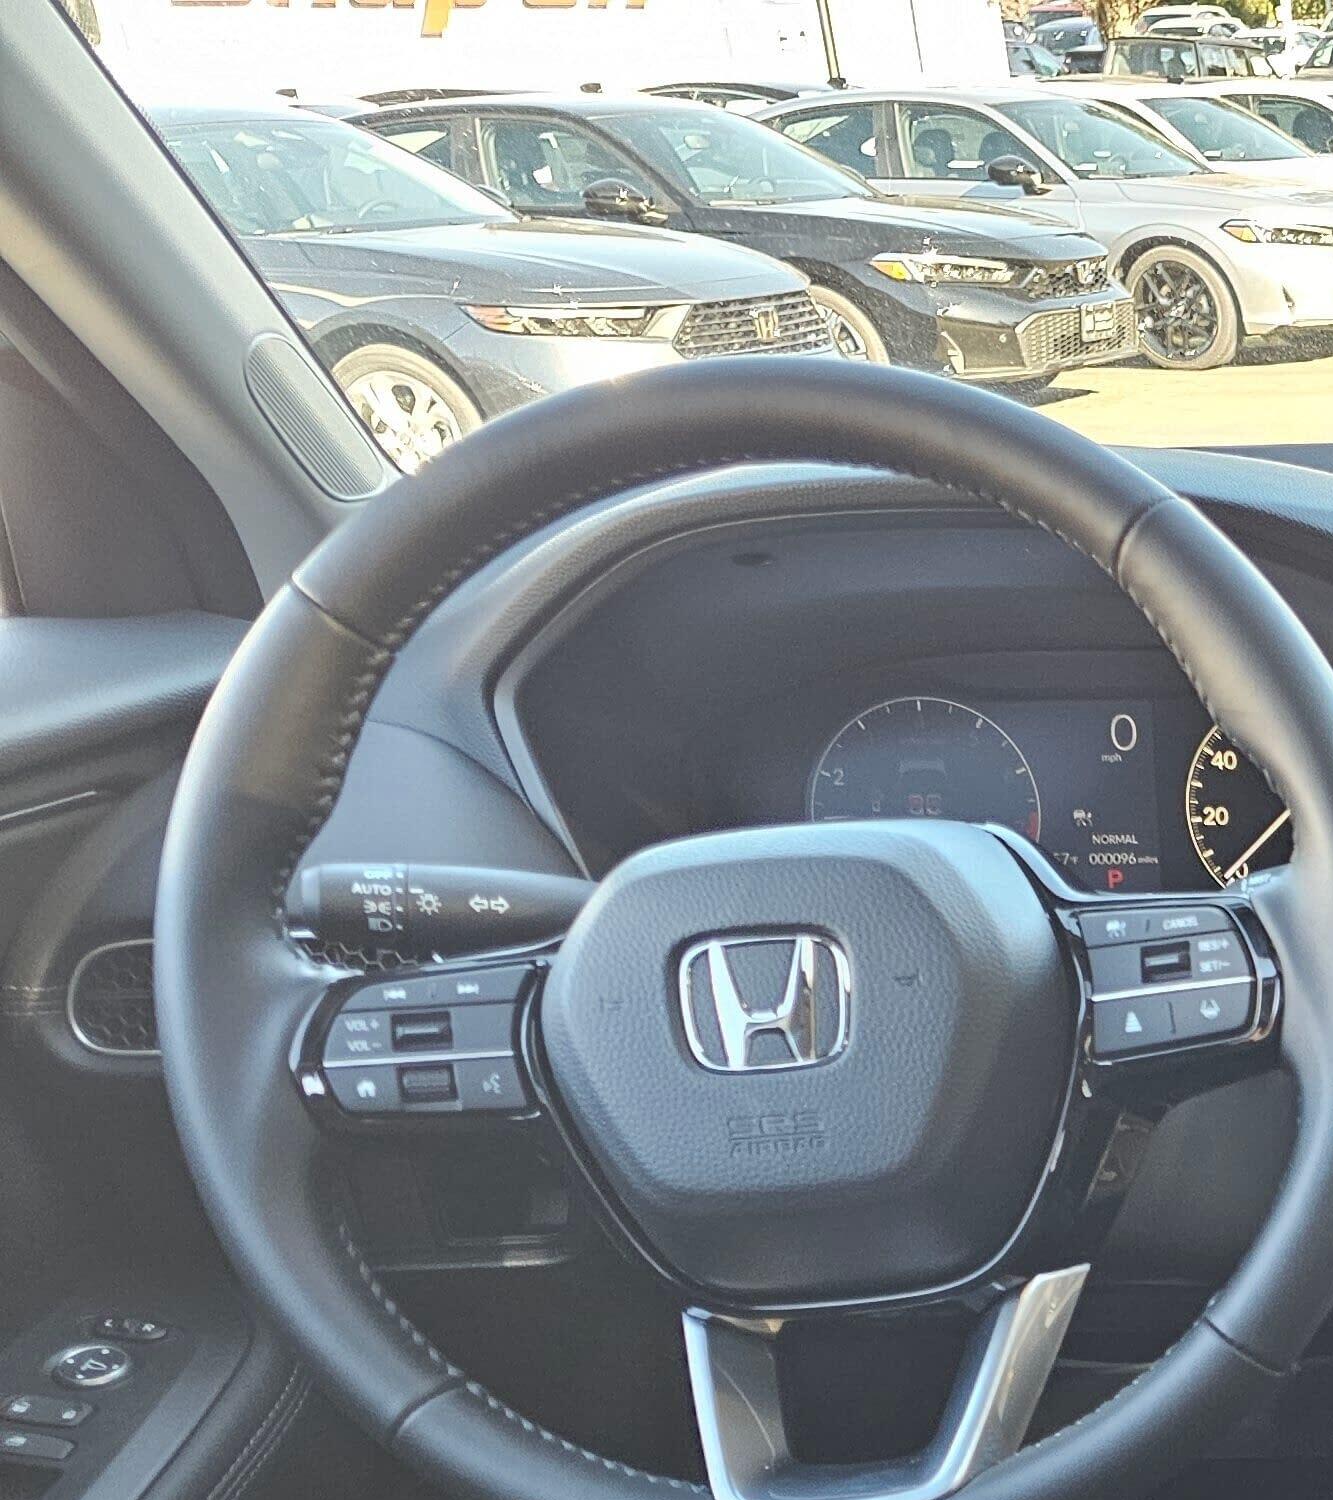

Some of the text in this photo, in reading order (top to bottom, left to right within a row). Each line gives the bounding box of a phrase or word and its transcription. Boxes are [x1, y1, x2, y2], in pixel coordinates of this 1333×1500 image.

[1101, 752, 1123, 763] mph
[1211, 750, 1238, 770] 40
[1203, 806, 1229, 826] 20
[1091, 834, 1139, 844] NORMAL
[1089, 853, 1137, 865] 000096
[1108, 869, 1124, 889] P
[351, 882, 393, 896] AUTO
